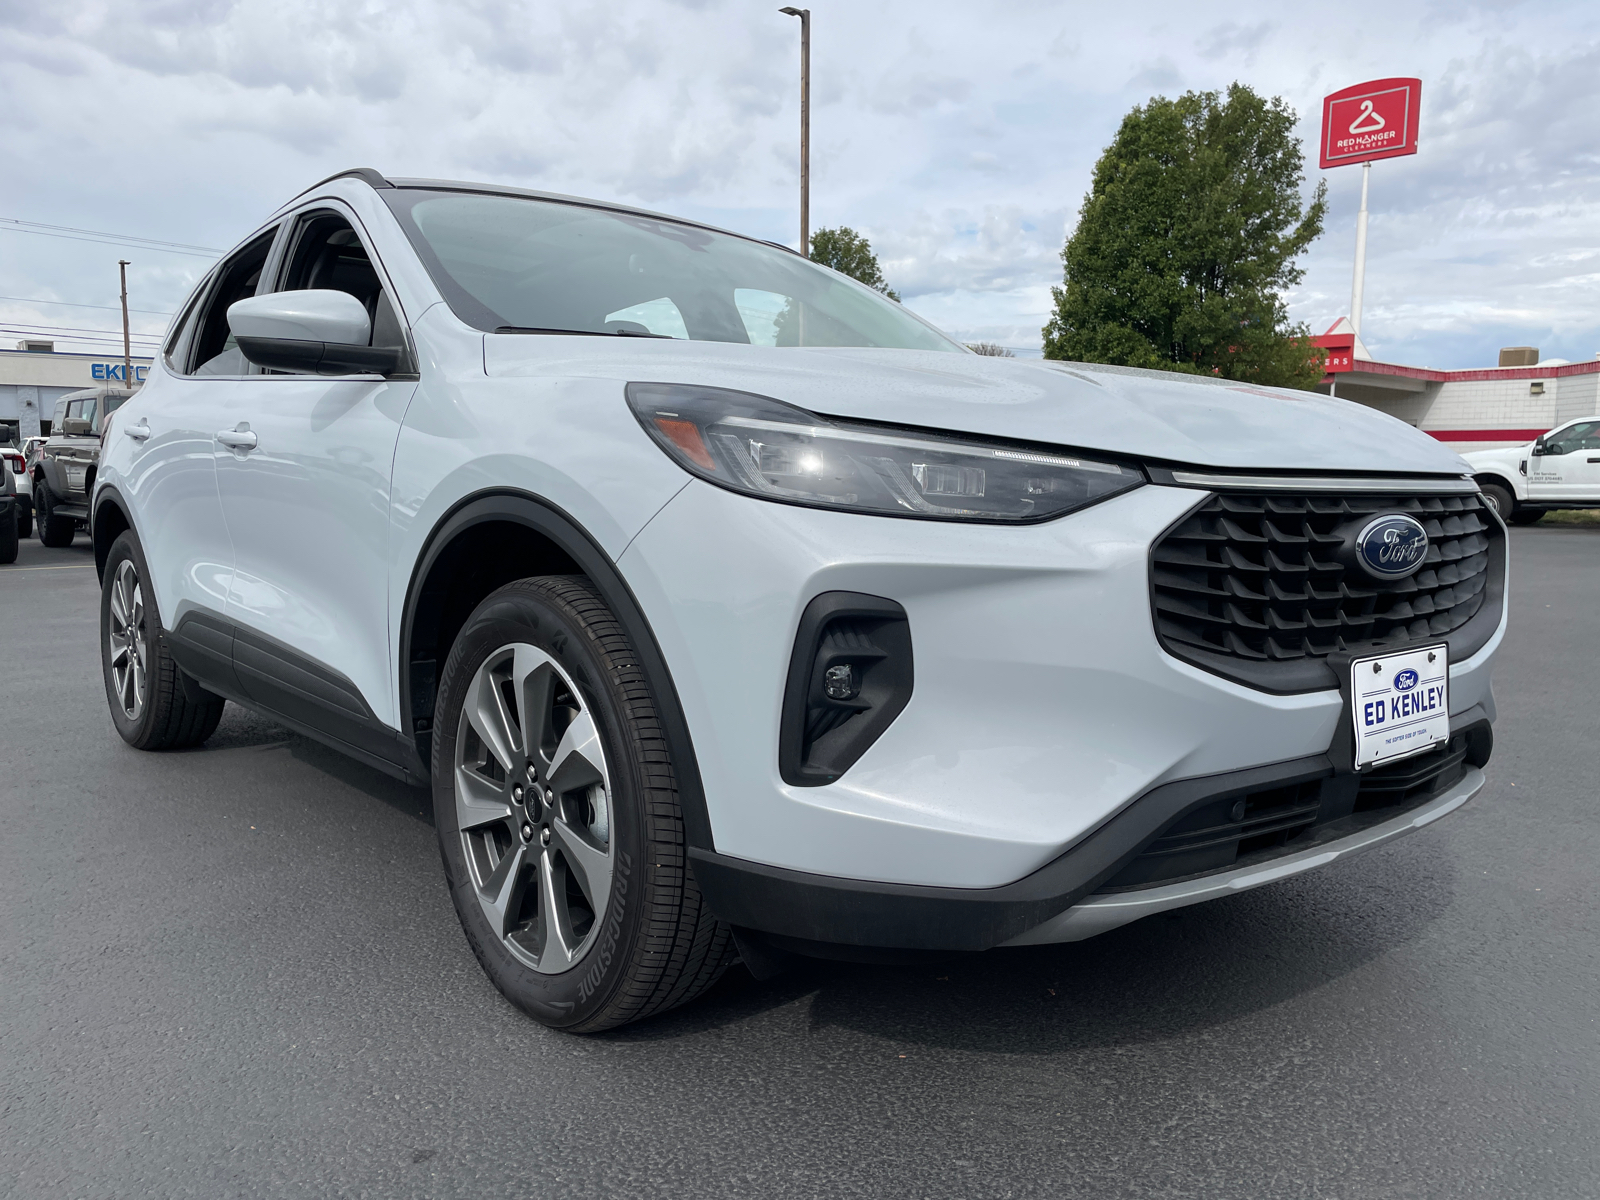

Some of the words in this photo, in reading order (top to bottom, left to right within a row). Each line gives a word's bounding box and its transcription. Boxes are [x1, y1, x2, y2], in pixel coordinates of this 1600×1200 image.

[1337, 138, 1354, 147] RED
[1344, 140, 1387, 151] CLEANERS
[91, 363, 151, 381] EKFC
[1379, 528, 1418, 563] Ford
[1398, 672, 1415, 689] Ford
[1364, 700, 1386, 727] ED
[1391, 685, 1444, 720] KENLEY
[577, 848, 631, 1004] BRIDGESTONE
